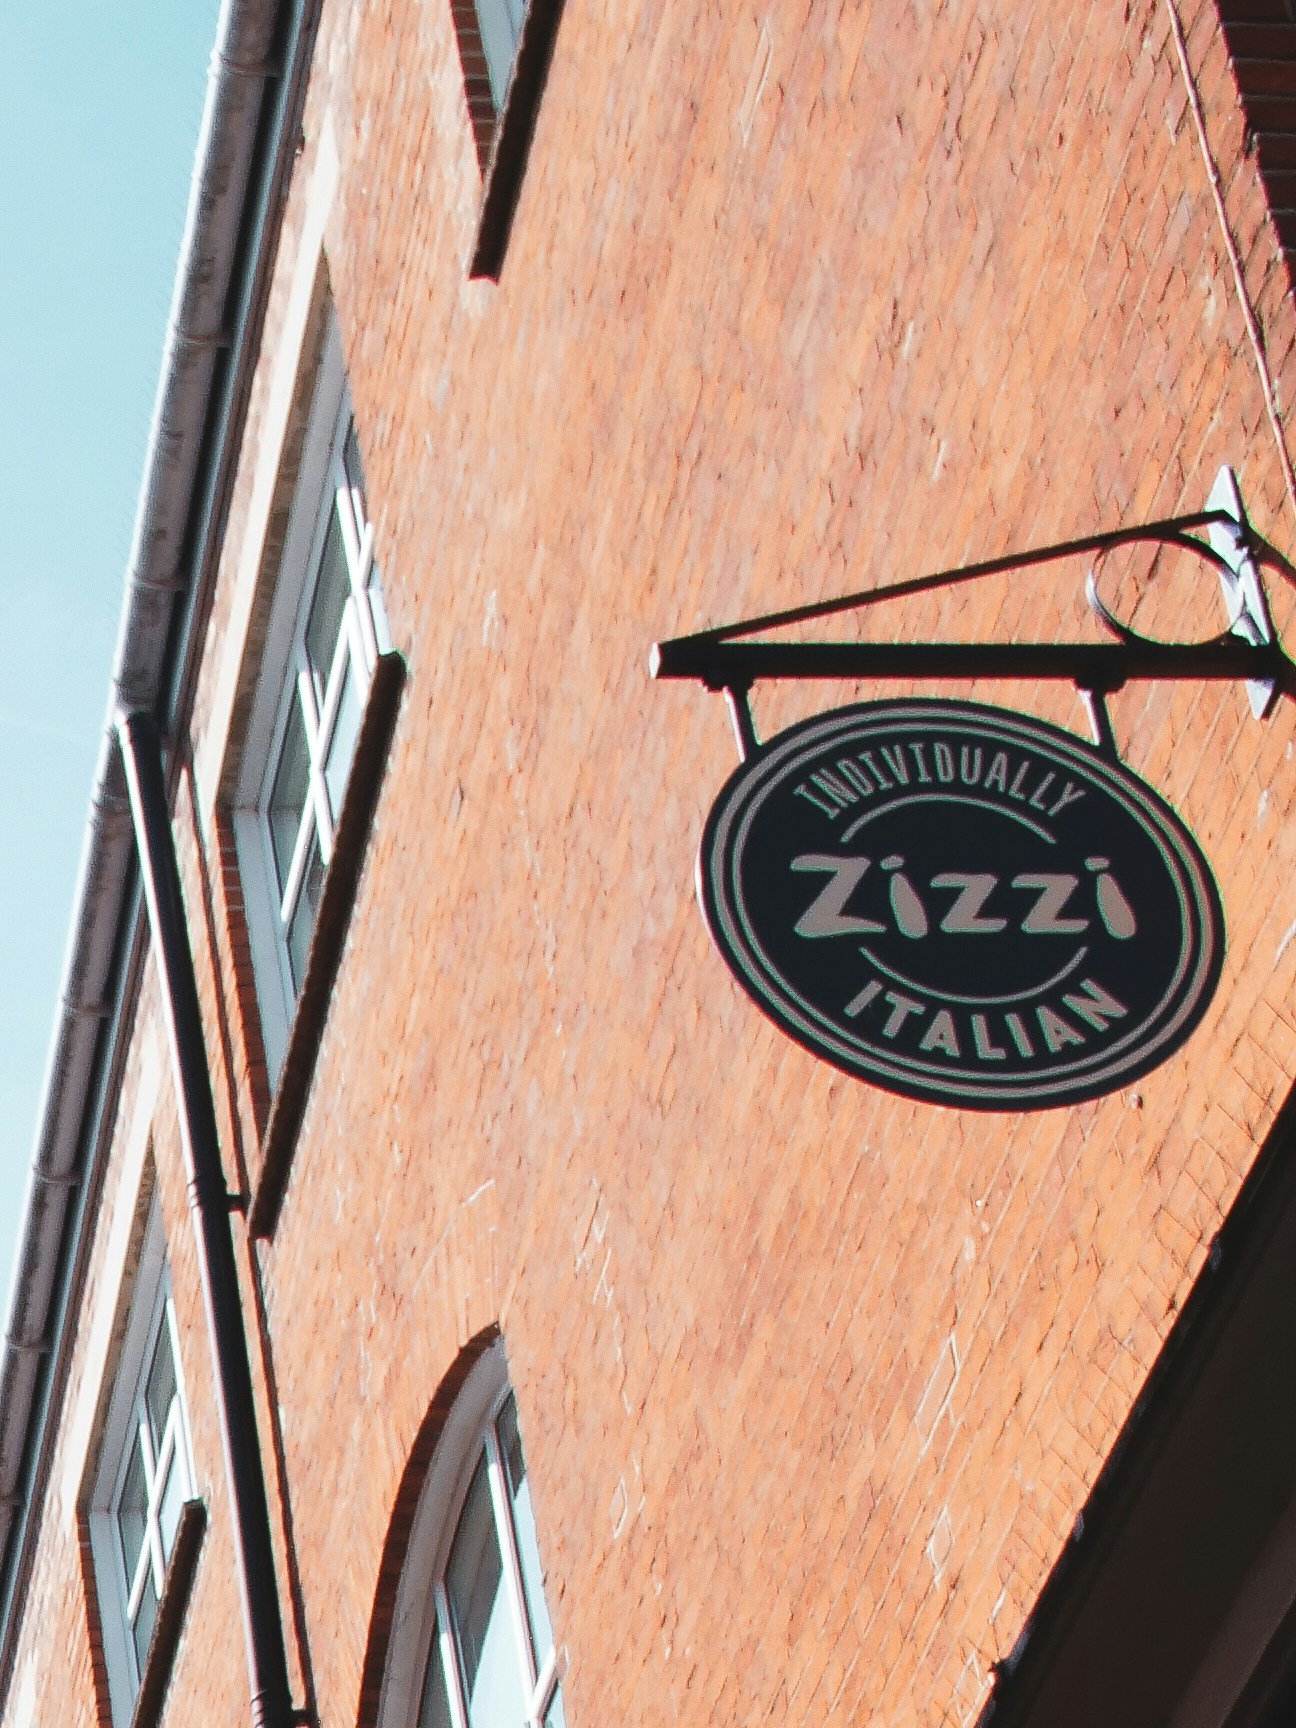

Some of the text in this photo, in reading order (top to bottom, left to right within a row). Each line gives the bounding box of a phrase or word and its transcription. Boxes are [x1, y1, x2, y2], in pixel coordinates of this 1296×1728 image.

[793, 741, 1087, 821] INDIVIDUALLY
[788, 854, 1137, 939] Zizzi
[844, 978, 1129, 1060] ITALIAN
